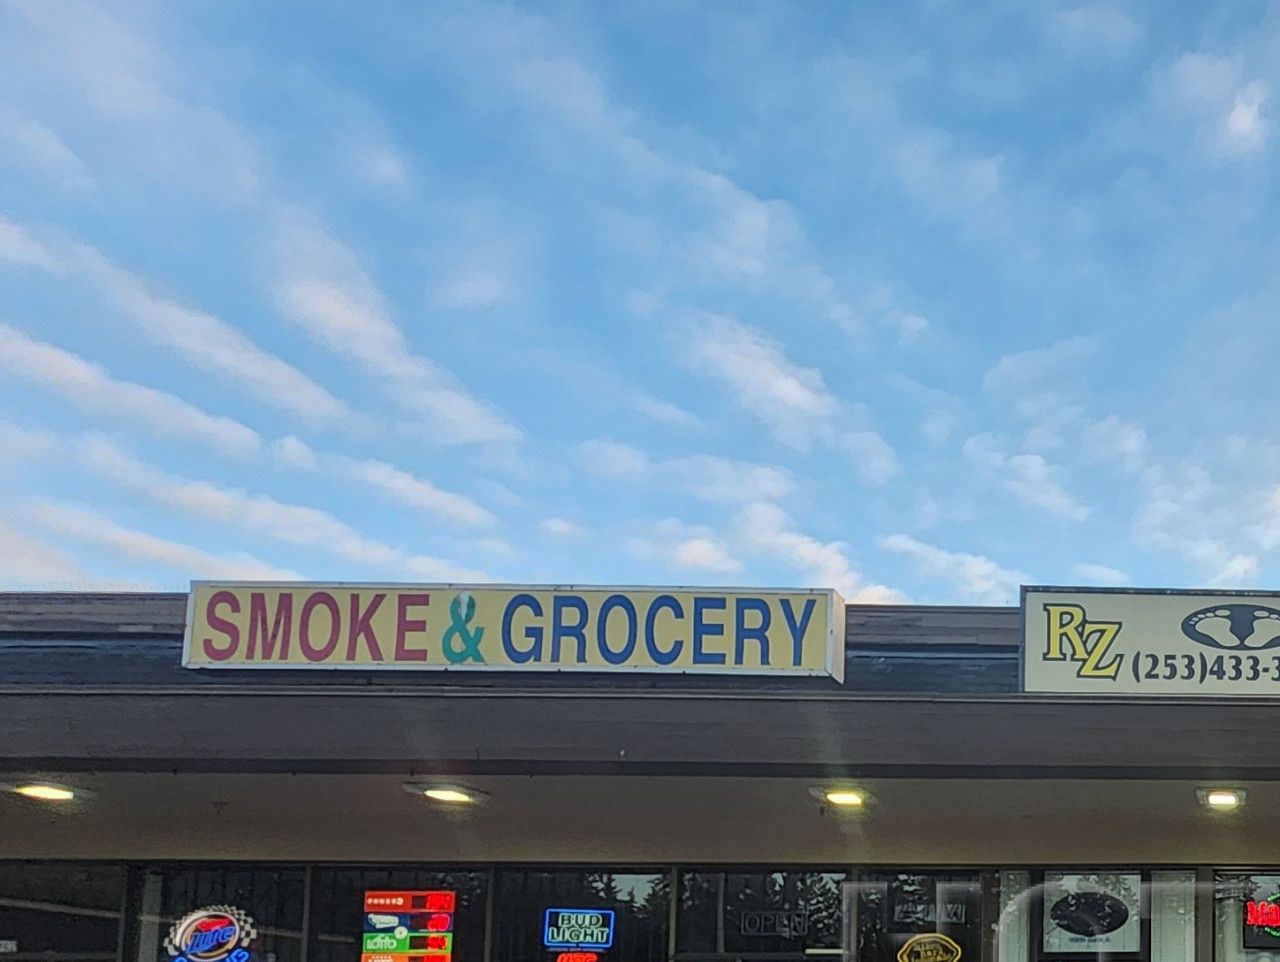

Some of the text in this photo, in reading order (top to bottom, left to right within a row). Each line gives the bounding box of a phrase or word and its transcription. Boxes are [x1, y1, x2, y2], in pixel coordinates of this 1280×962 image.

[203, 590, 817, 667] SMOKE & GROCERY
[559, 913, 602, 927] BUD
[549, 927, 609, 942] LIGHT
